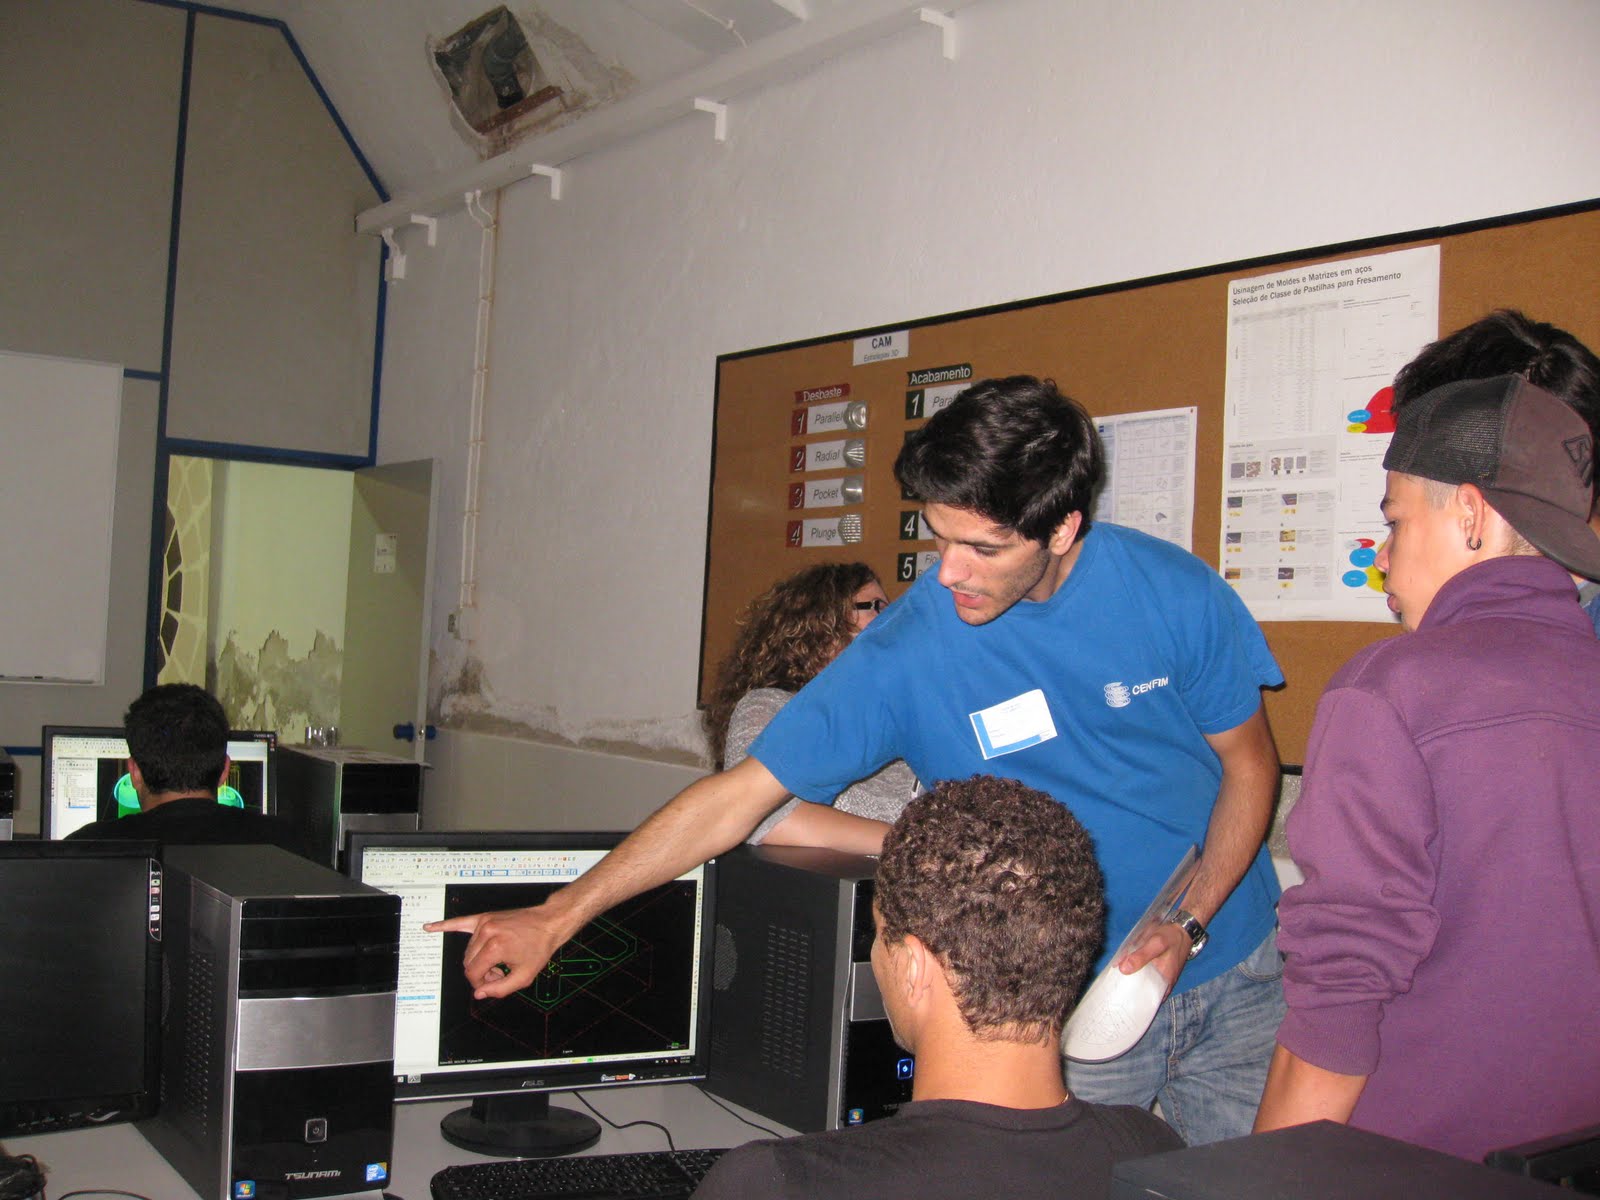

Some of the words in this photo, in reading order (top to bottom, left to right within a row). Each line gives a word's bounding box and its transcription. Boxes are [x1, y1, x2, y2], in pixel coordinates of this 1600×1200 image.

[1232, 284, 1265, 296] Usinagem
[1276, 278, 1300, 287] Moldes
[1308, 270, 1339, 282] Matrizes
[1340, 268, 1353, 276] em
[1354, 265, 1373, 275] aços
[1232, 295, 1258, 306] Seleção
[1269, 289, 1292, 300] Classe
[1293, 288, 1302, 296] de
[1303, 282, 1336, 294] Pastilhas
[1337, 280, 1354, 290] para
[1356, 272, 1402, 285] Fresamento
[871, 335, 893, 350] CAM
[909, 365, 971, 385] Acabamento
[803, 387, 842, 402] Desbaste
[911, 393, 920, 416] 1
[932, 393, 957, 408] Para
[797, 412, 805, 434] 1
[794, 451, 805, 472] 2
[814, 449, 840, 463] Radial
[793, 487, 803, 508] 3
[813, 487, 839, 500] Pocket
[791, 525, 801, 546] 4
[810, 527, 837, 541] Plunge
[904, 514, 916, 537] 4
[902, 556, 914, 579] 5
[1131, 676, 1169, 696] CENFIM
[284, 1169, 342, 1181] TSUNAMI
